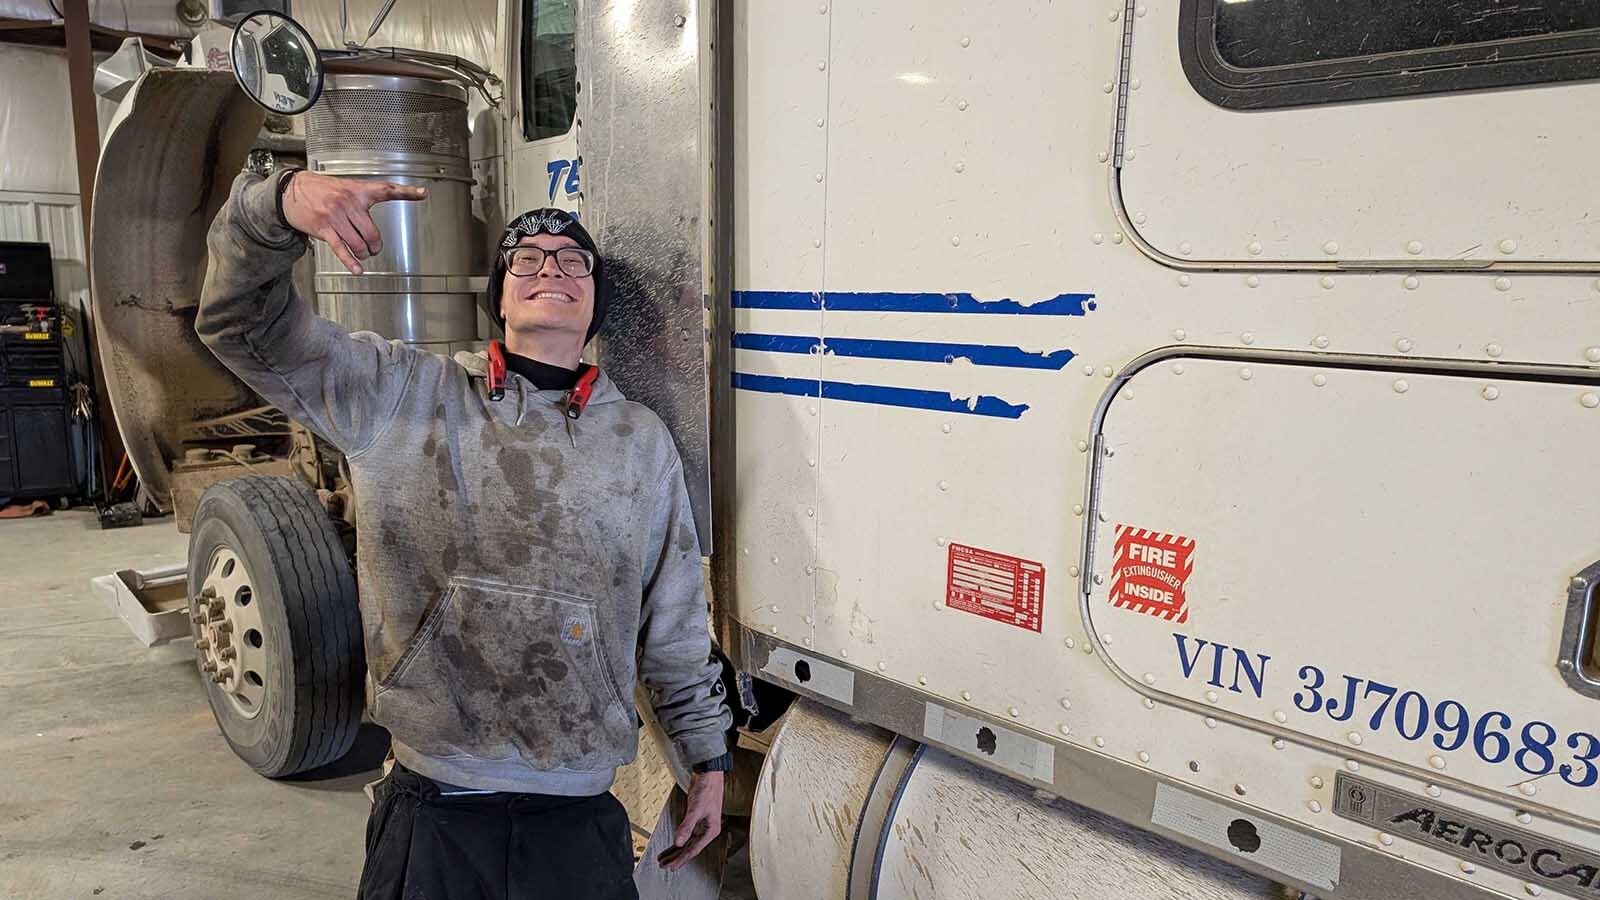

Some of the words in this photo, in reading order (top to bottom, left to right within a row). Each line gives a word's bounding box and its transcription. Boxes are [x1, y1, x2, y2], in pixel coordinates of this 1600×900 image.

[951, 545, 974, 555] FMCSA
[1129, 542, 1177, 569] FIRE
[1123, 565, 1181, 590] EXTINGUISHER
[1124, 582, 1175, 605] INSIDE
[1172, 633, 1271, 698] VIN
[1292, 665, 1600, 788] 3J709683
[1389, 807, 1600, 889] AEROCA
